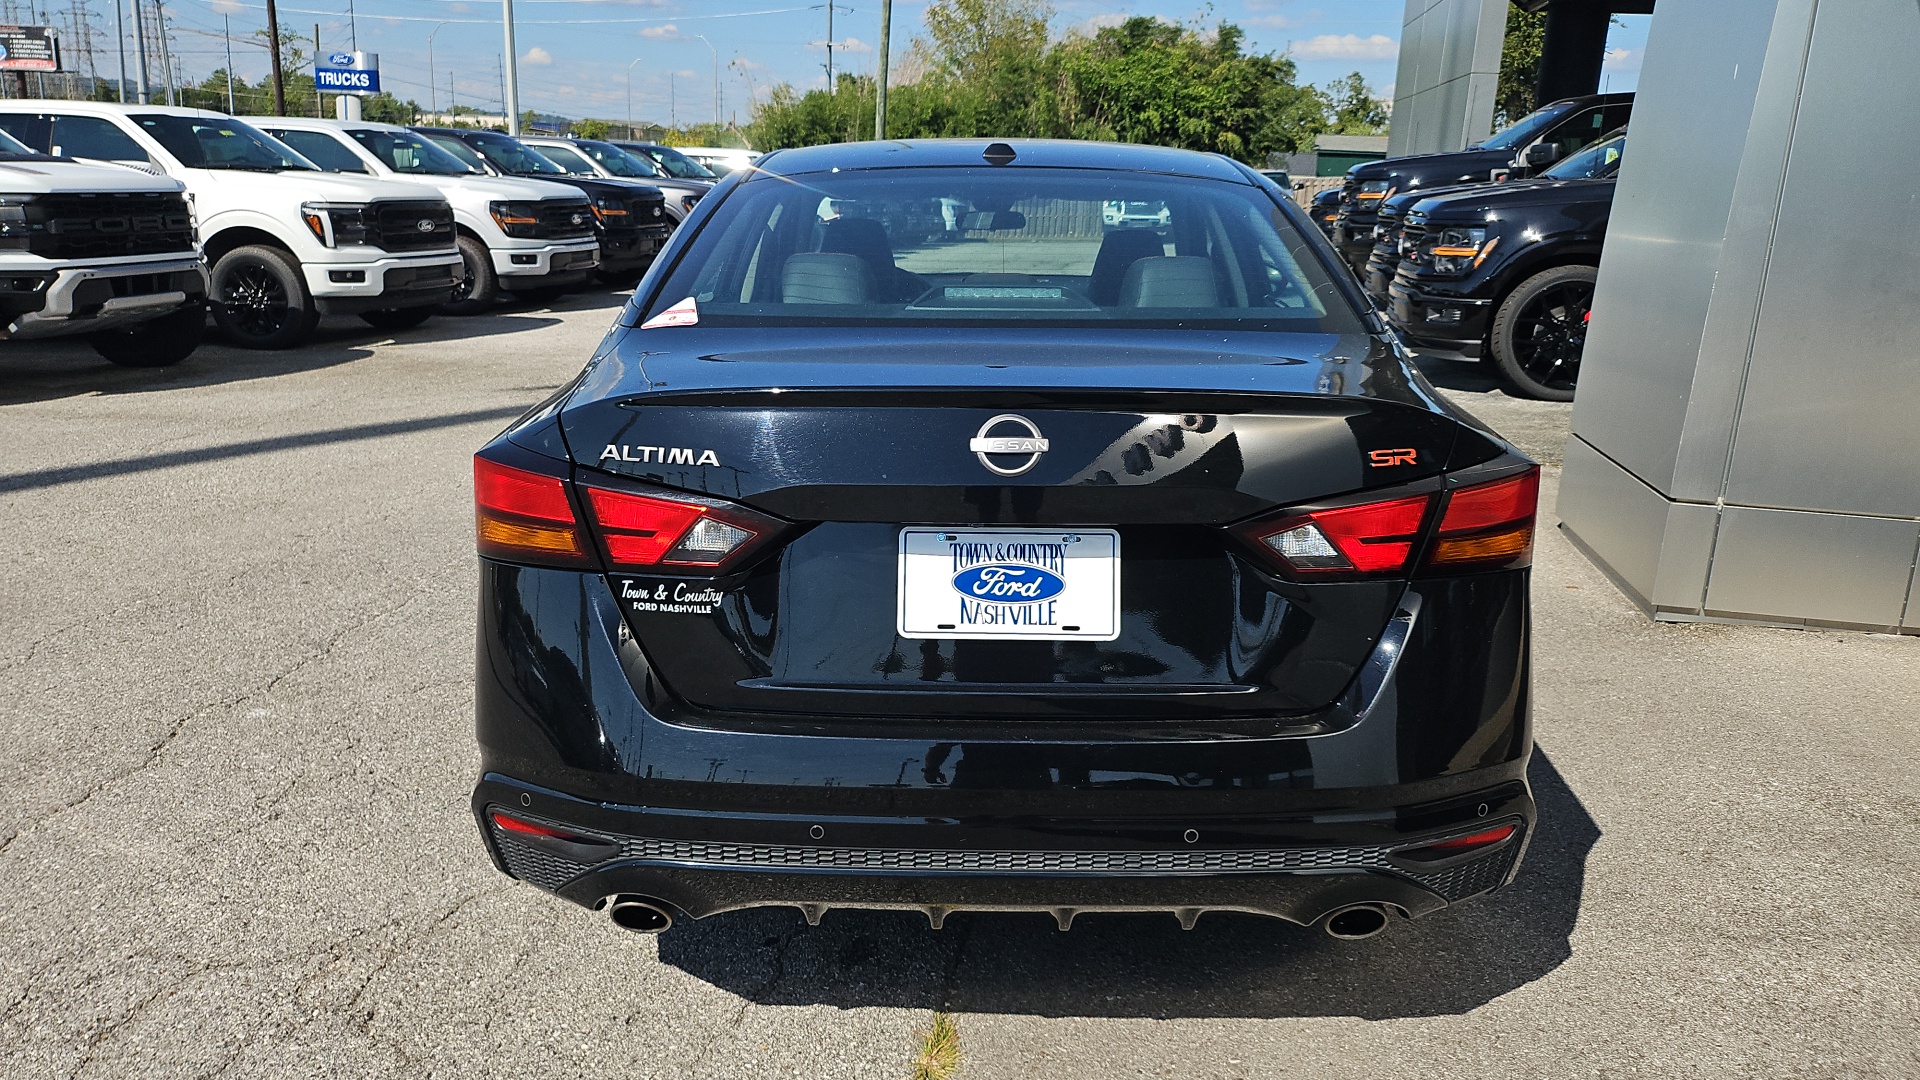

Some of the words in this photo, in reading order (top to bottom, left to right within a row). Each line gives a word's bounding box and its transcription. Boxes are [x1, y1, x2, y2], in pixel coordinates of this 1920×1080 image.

[332, 54, 350, 64] Ford
[319, 71, 370, 87] TRUCKS
[600, 444, 721, 467] ALTIMA
[976, 440, 1047, 451] ISSAN
[1368, 448, 1417, 467] SR
[950, 543, 993, 574] TOWN
[995, 542, 1007, 562] &
[1006, 543, 1068, 578] COUNTRY
[973, 567, 1043, 597] Ford
[621, 580, 650, 599] Town
[654, 584, 668, 600] &
[673, 582, 724, 608] Country
[633, 601, 658, 612] FORD
[660, 603, 712, 614] NASHVILLE
[960, 596, 1057, 626] NASHVILLE
